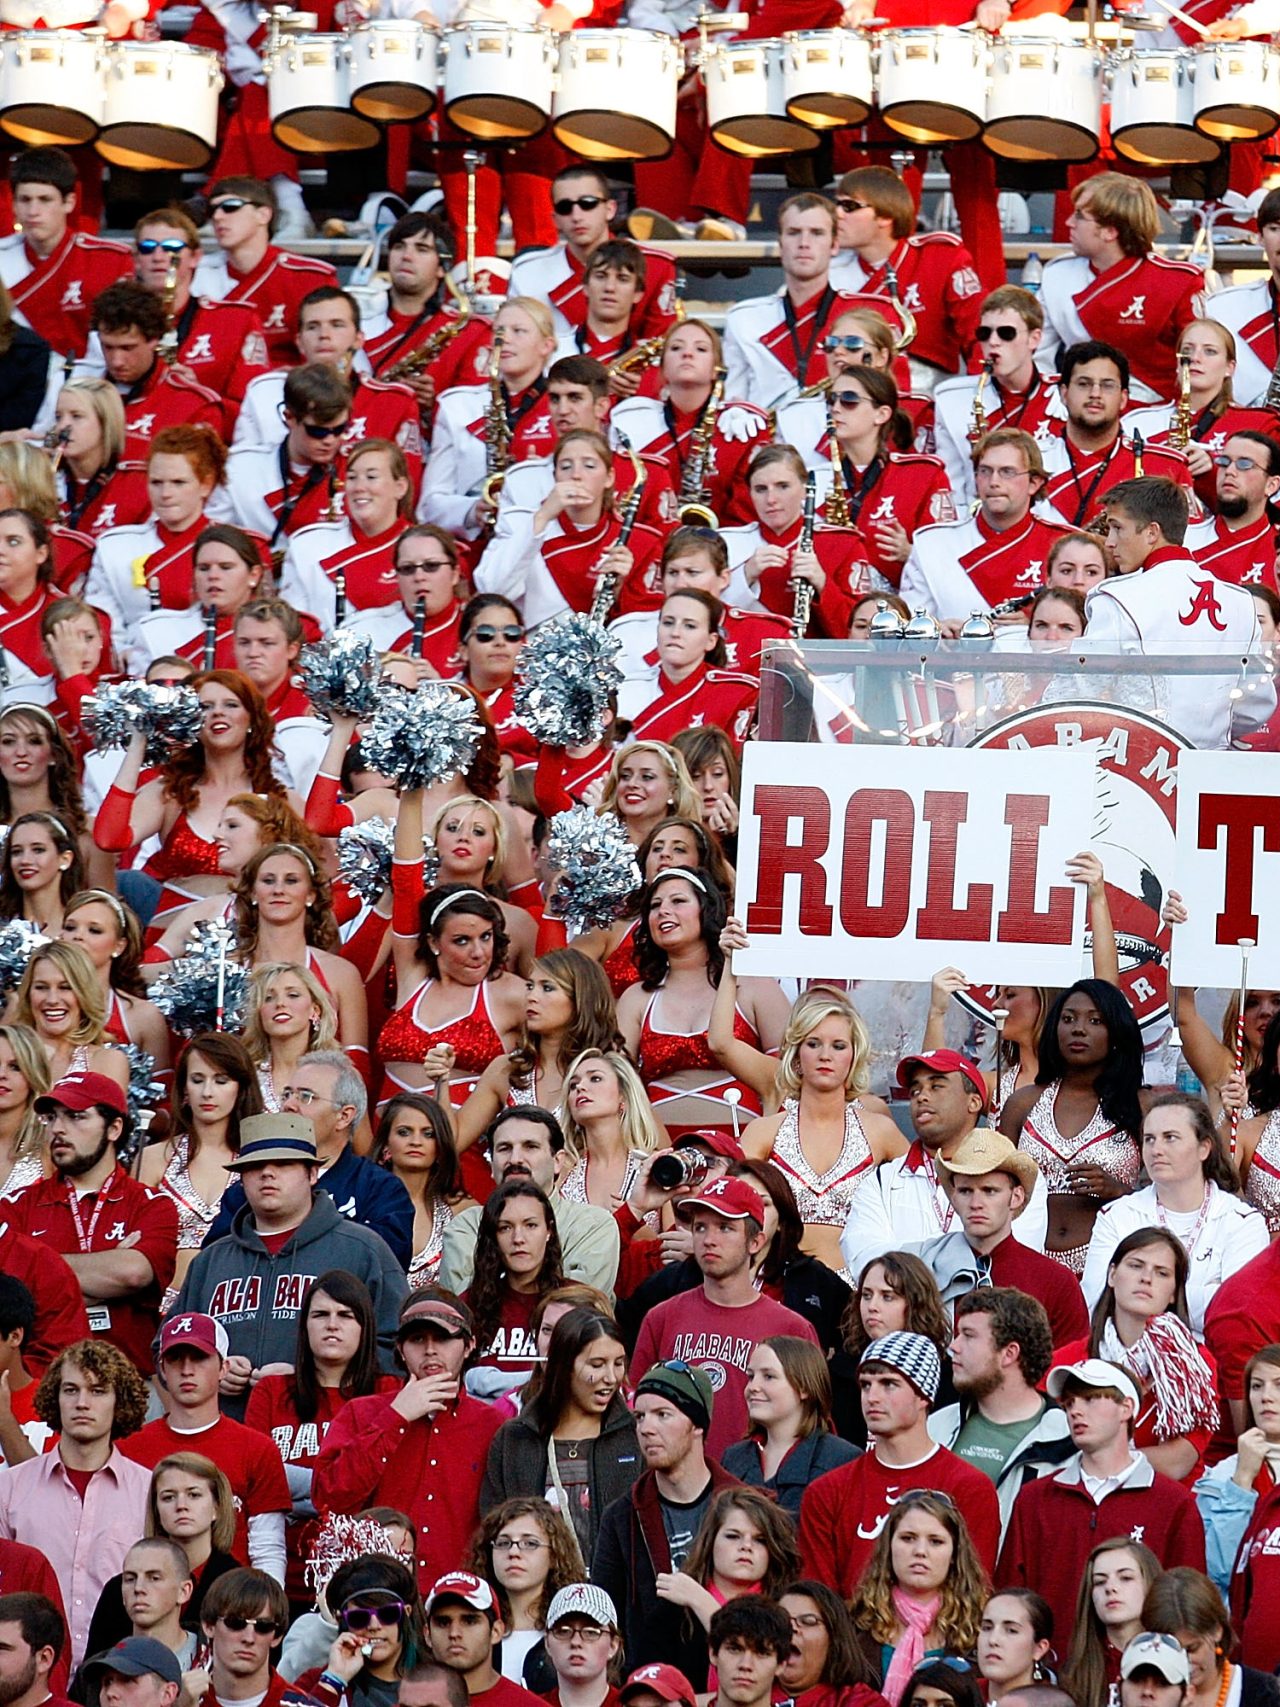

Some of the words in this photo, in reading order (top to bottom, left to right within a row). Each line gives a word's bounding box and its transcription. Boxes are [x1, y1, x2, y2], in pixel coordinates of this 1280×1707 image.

[1120, 296, 1145, 319] A
[524, 415, 551, 434] A
[94, 504, 117, 527] A
[869, 496, 896, 519] A
[1016, 561, 1043, 583] A
[1241, 563, 1265, 584] A
[1178, 580, 1228, 632] A
[746, 784, 1076, 945] ROLL
[704, 1179, 728, 1195] A
[105, 1222, 126, 1240] A
[1197, 1248, 1213, 1261] A
[271, 1310, 296, 1320] TIDE
[171, 1317, 193, 1335] A
[672, 1333, 757, 1373] ALABAM
